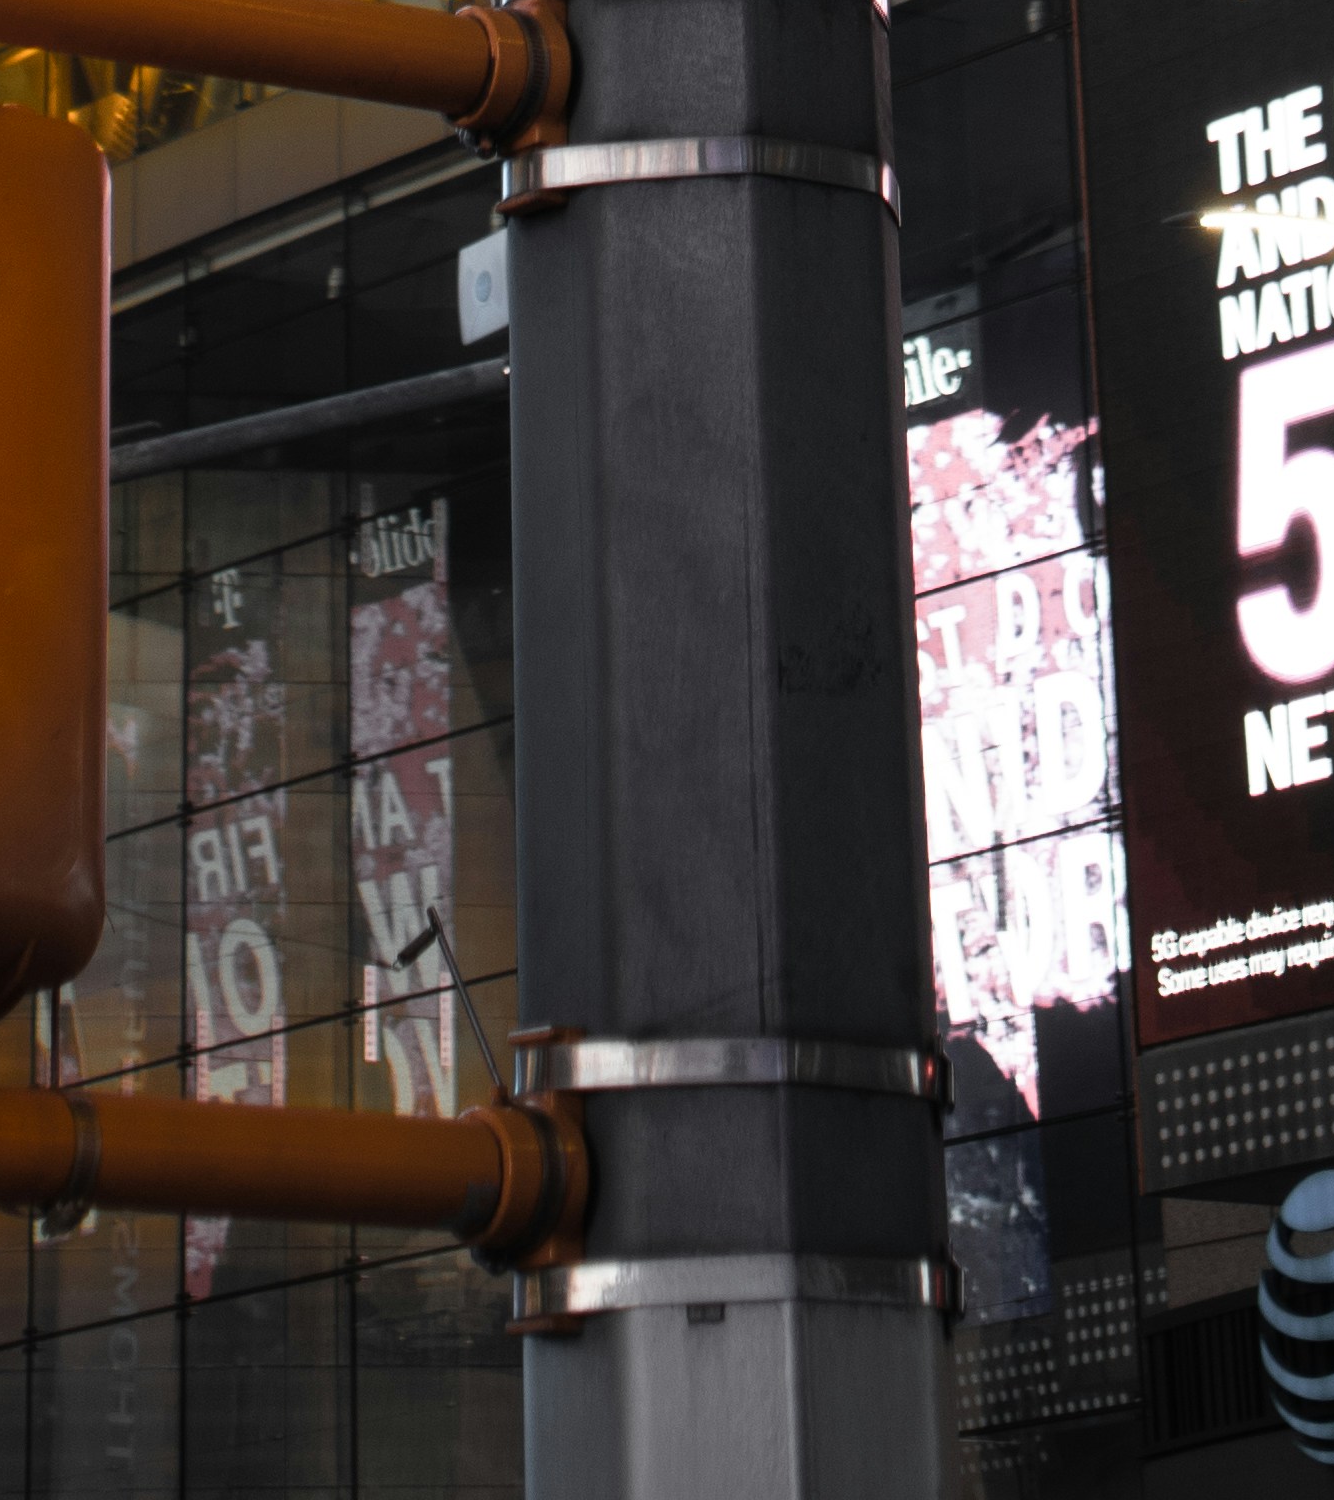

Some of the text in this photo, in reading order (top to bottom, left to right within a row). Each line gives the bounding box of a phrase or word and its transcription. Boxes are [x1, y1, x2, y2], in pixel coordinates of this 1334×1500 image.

[1206, 85, 1327, 195] THE
[1151, 929, 1179, 963] 5G
[1157, 965, 1209, 997] Some
